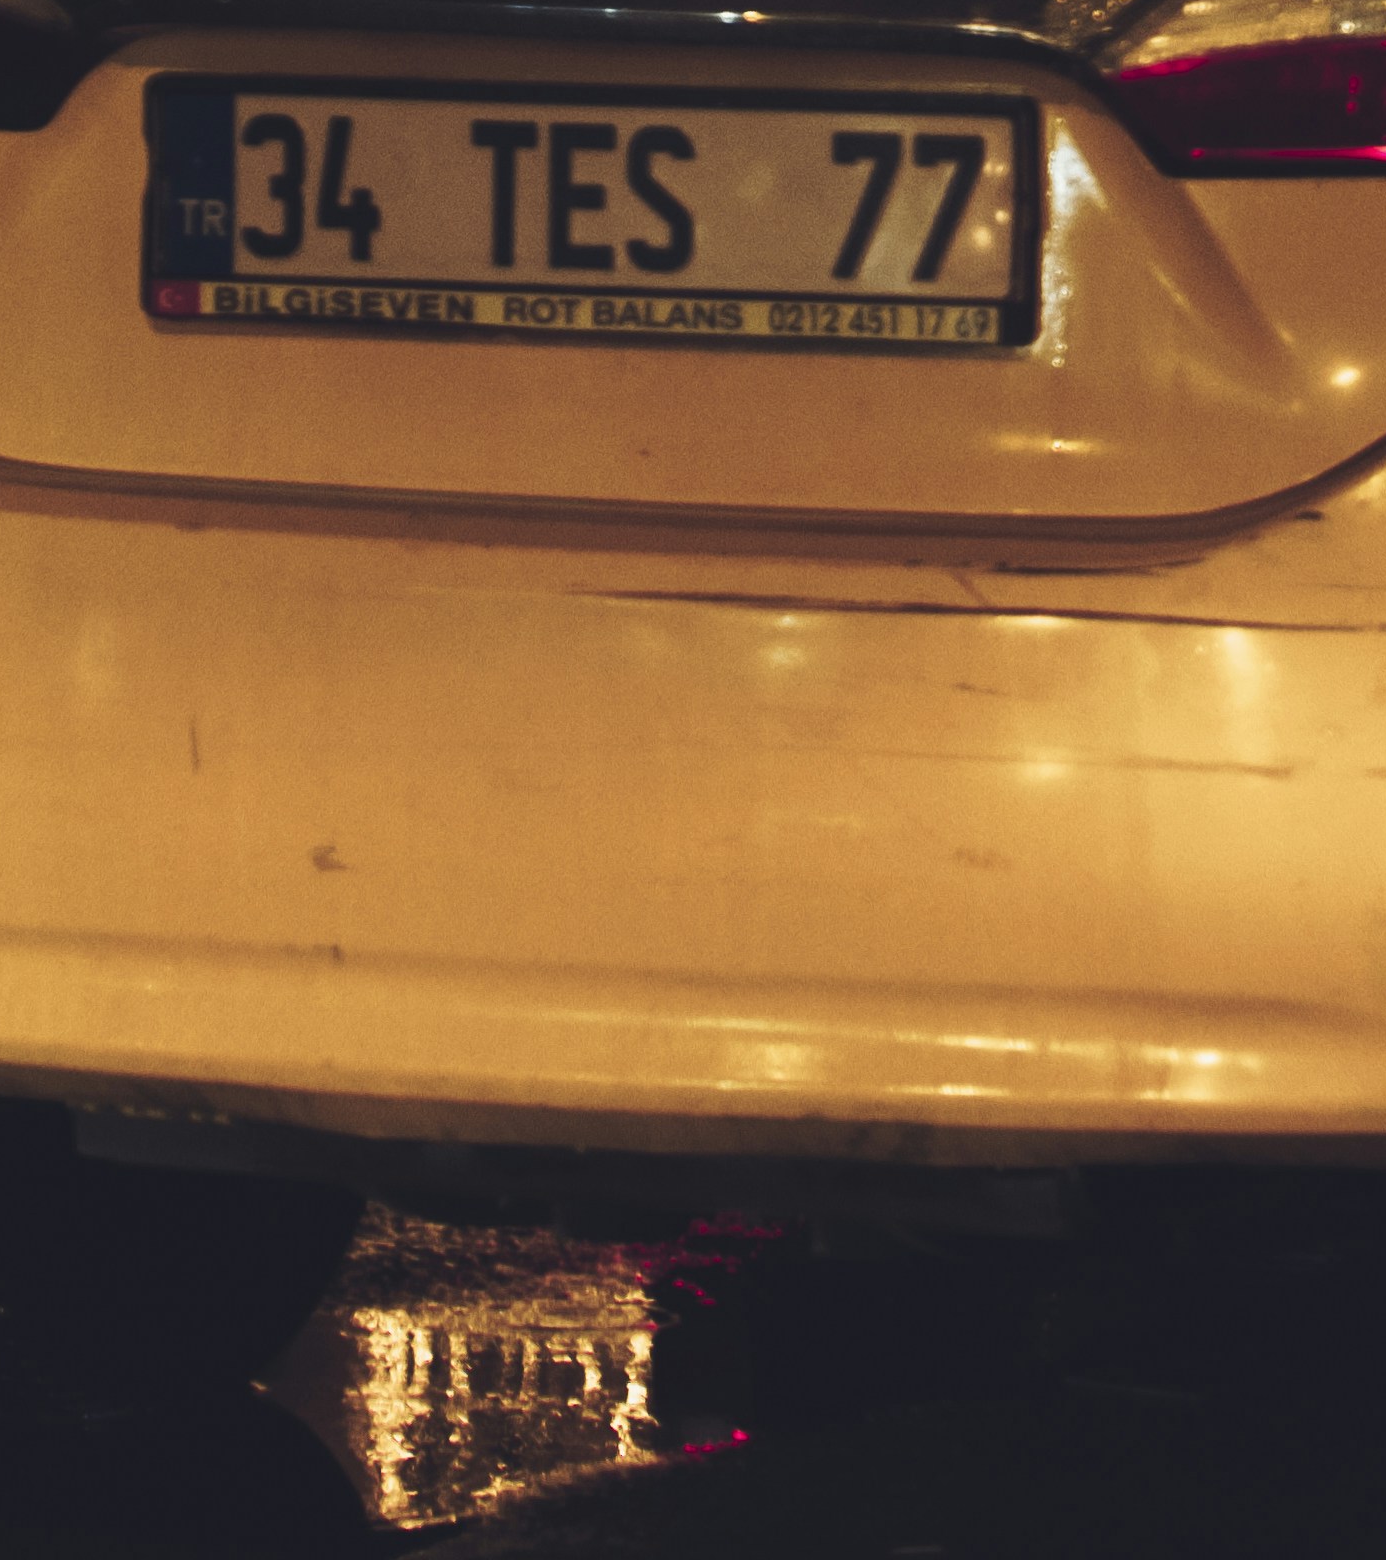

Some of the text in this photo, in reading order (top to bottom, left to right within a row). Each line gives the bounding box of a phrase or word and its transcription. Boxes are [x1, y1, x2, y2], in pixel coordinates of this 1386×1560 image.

[178, 197, 227, 237] TR
[240, 114, 985, 281] 34 TES 77
[504, 298, 580, 324] ROT
[593, 298, 742, 329] BALANS
